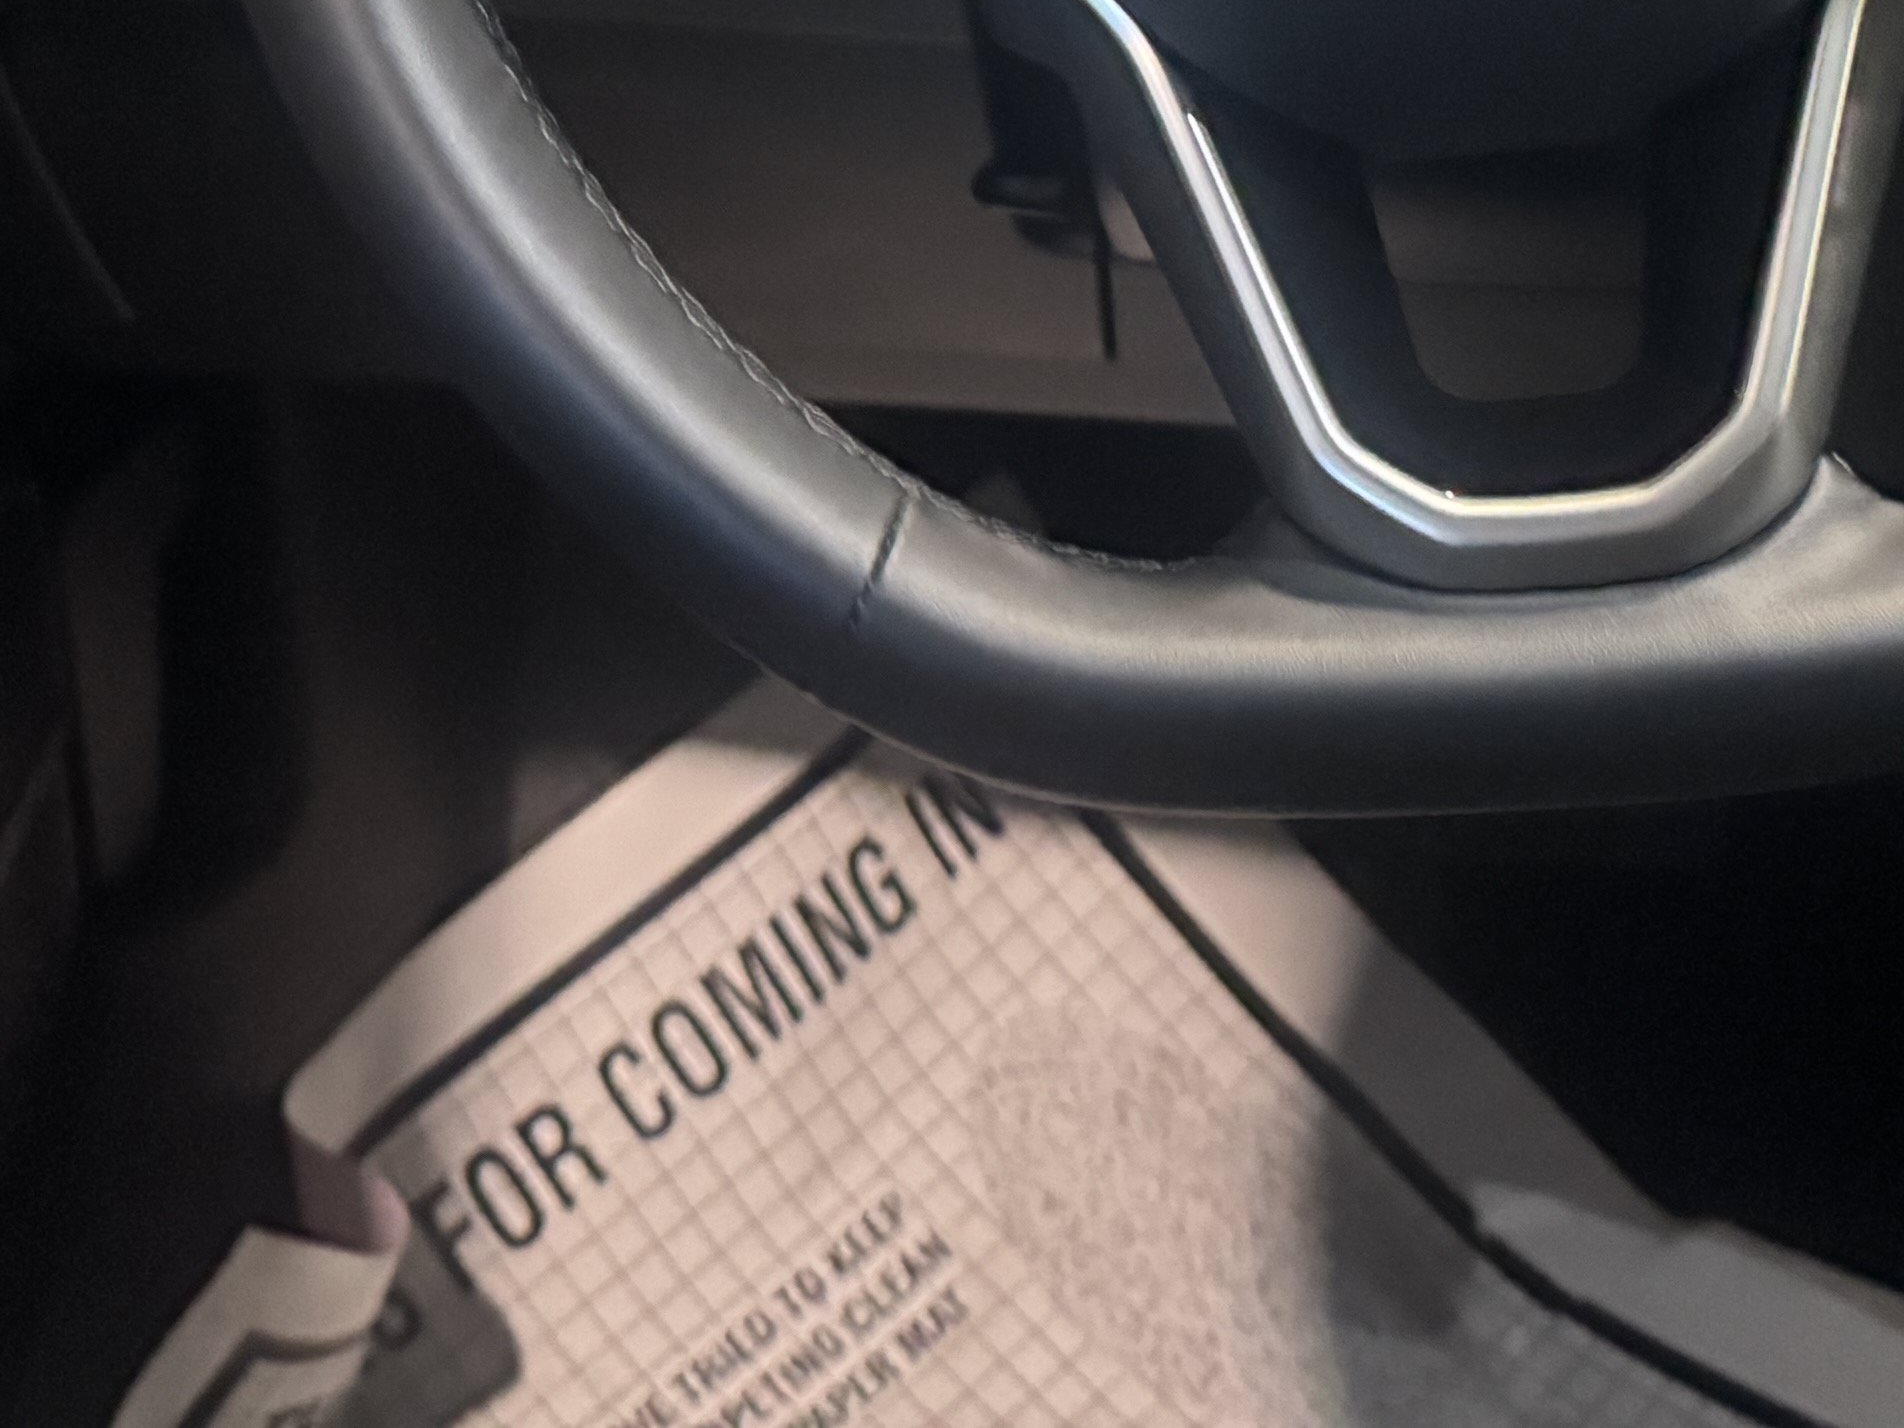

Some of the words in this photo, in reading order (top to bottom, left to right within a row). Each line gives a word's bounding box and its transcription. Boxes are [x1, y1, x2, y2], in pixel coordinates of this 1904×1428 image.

[408, 1102, 608, 1294] FOR
[596, 833, 919, 1140] COMING
[773, 1264, 828, 1322] TO
[826, 1191, 904, 1278] KEEP
[841, 1227, 953, 1336] CLEAN
